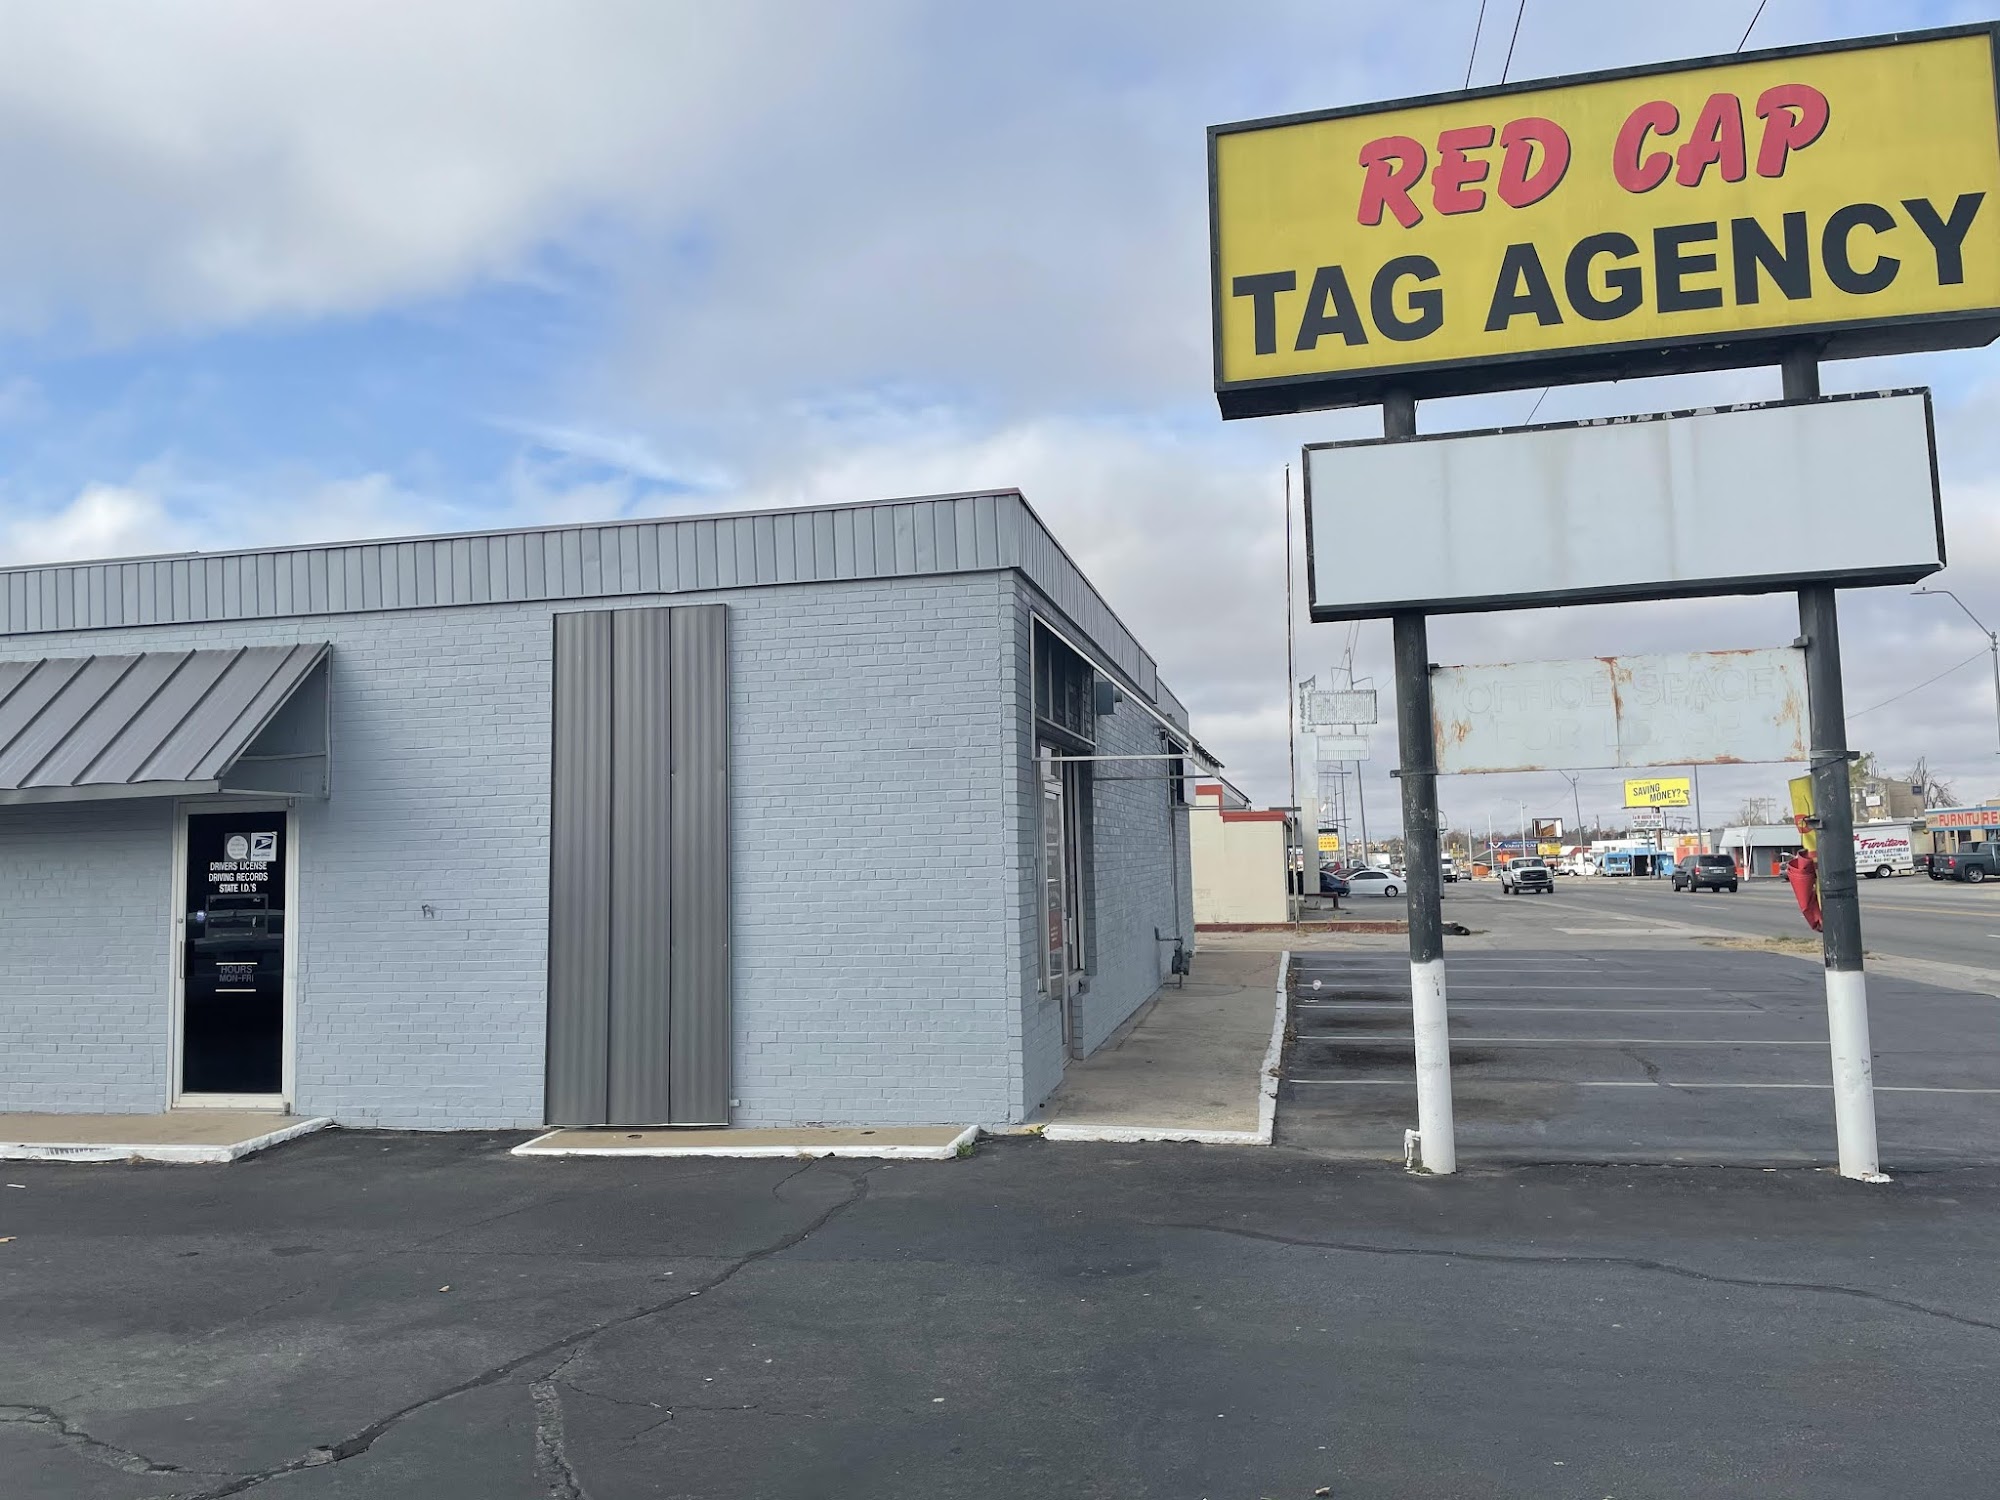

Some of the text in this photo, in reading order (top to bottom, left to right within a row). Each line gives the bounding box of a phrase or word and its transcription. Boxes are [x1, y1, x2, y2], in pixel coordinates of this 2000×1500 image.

[1356, 83, 1829, 229] RED CAP
[1232, 192, 1986, 356] TAG AGENCY
[1633, 783, 1660, 796] SAVING
[1650, 788, 1681, 802] MONEY?
[1939, 811, 1998, 827] FURNITURE
[1860, 838, 1908, 849] Furniture
[210, 861, 267, 871] DRIVERS LICENSE
[208, 872, 269, 882] DRIVING RECORDS
[219, 884, 239, 893] STATE
[221, 965, 252, 974] HOURS
[219, 974, 254, 983] MON-FRI
